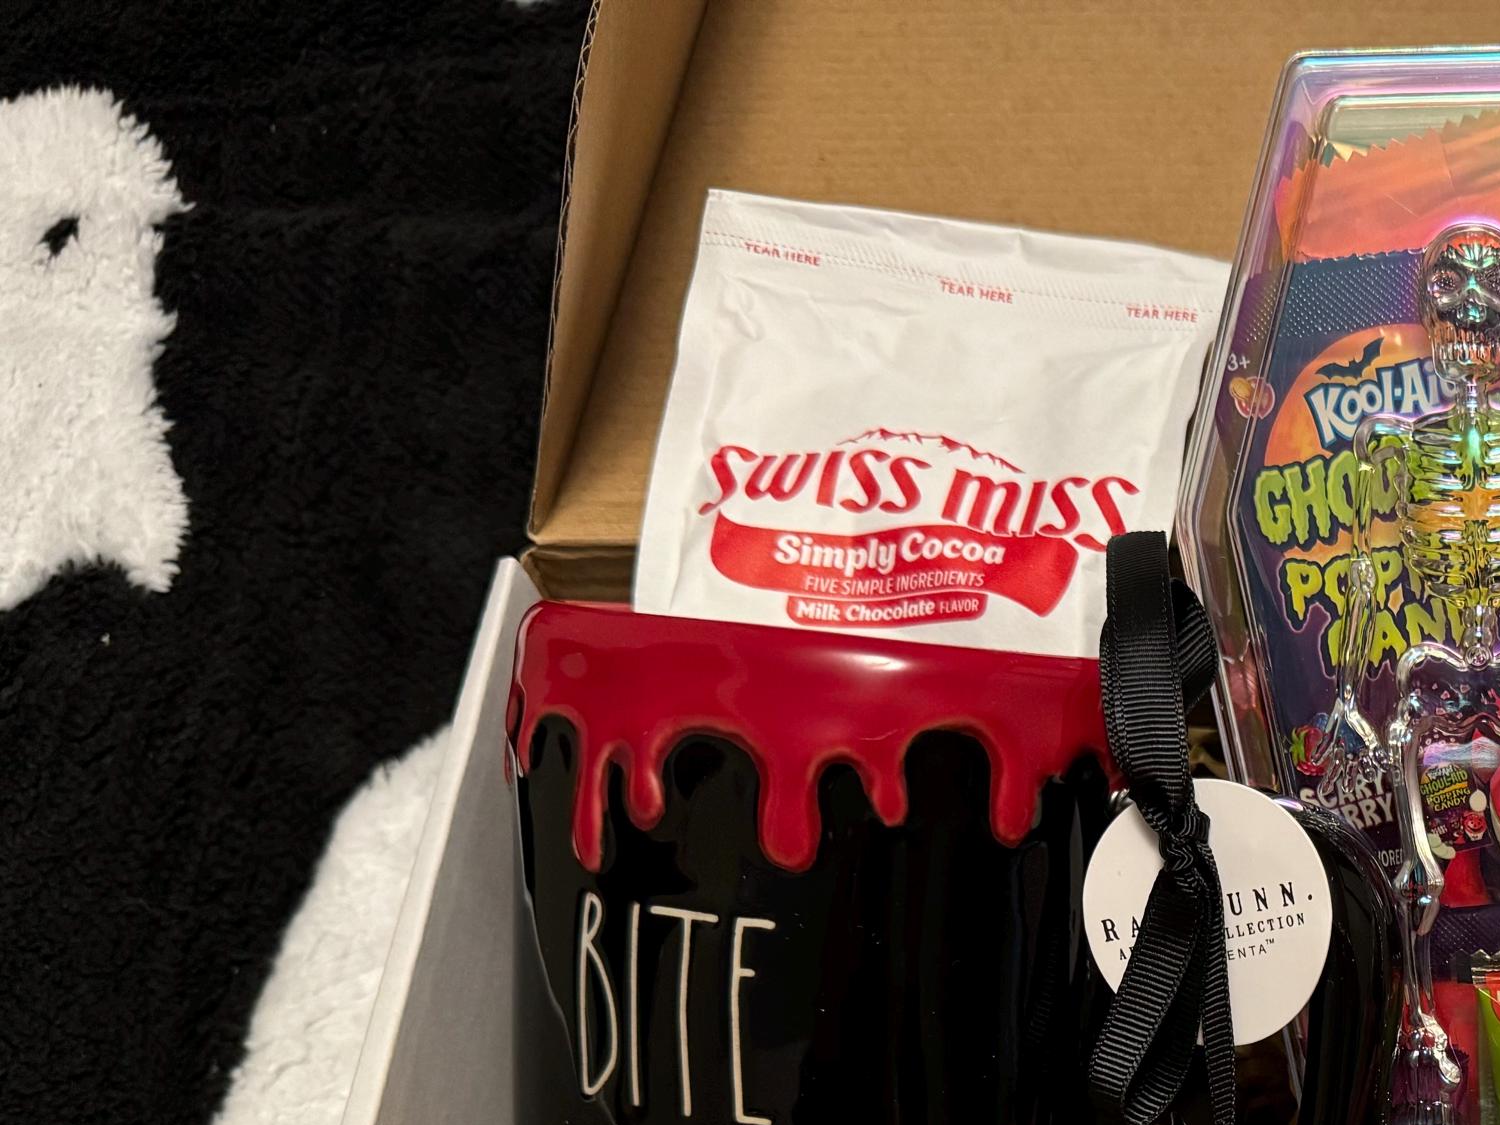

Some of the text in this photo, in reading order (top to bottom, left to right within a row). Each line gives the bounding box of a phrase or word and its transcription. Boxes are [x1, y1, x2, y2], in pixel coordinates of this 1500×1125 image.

[940, 280, 1014, 304] TEAR HERE
[1126, 306, 1198, 323] TEAR HERE
[774, 532, 1005, 576] Simply Cocoa
[804, 571, 984, 594] FIVE SIMPLE INGREDIENTS
[796, 598, 979, 622] Milk Chocolate FLAVOR
[1226, 882, 1313, 916] UNN.
[1226, 912, 1305, 940] LLECTION
